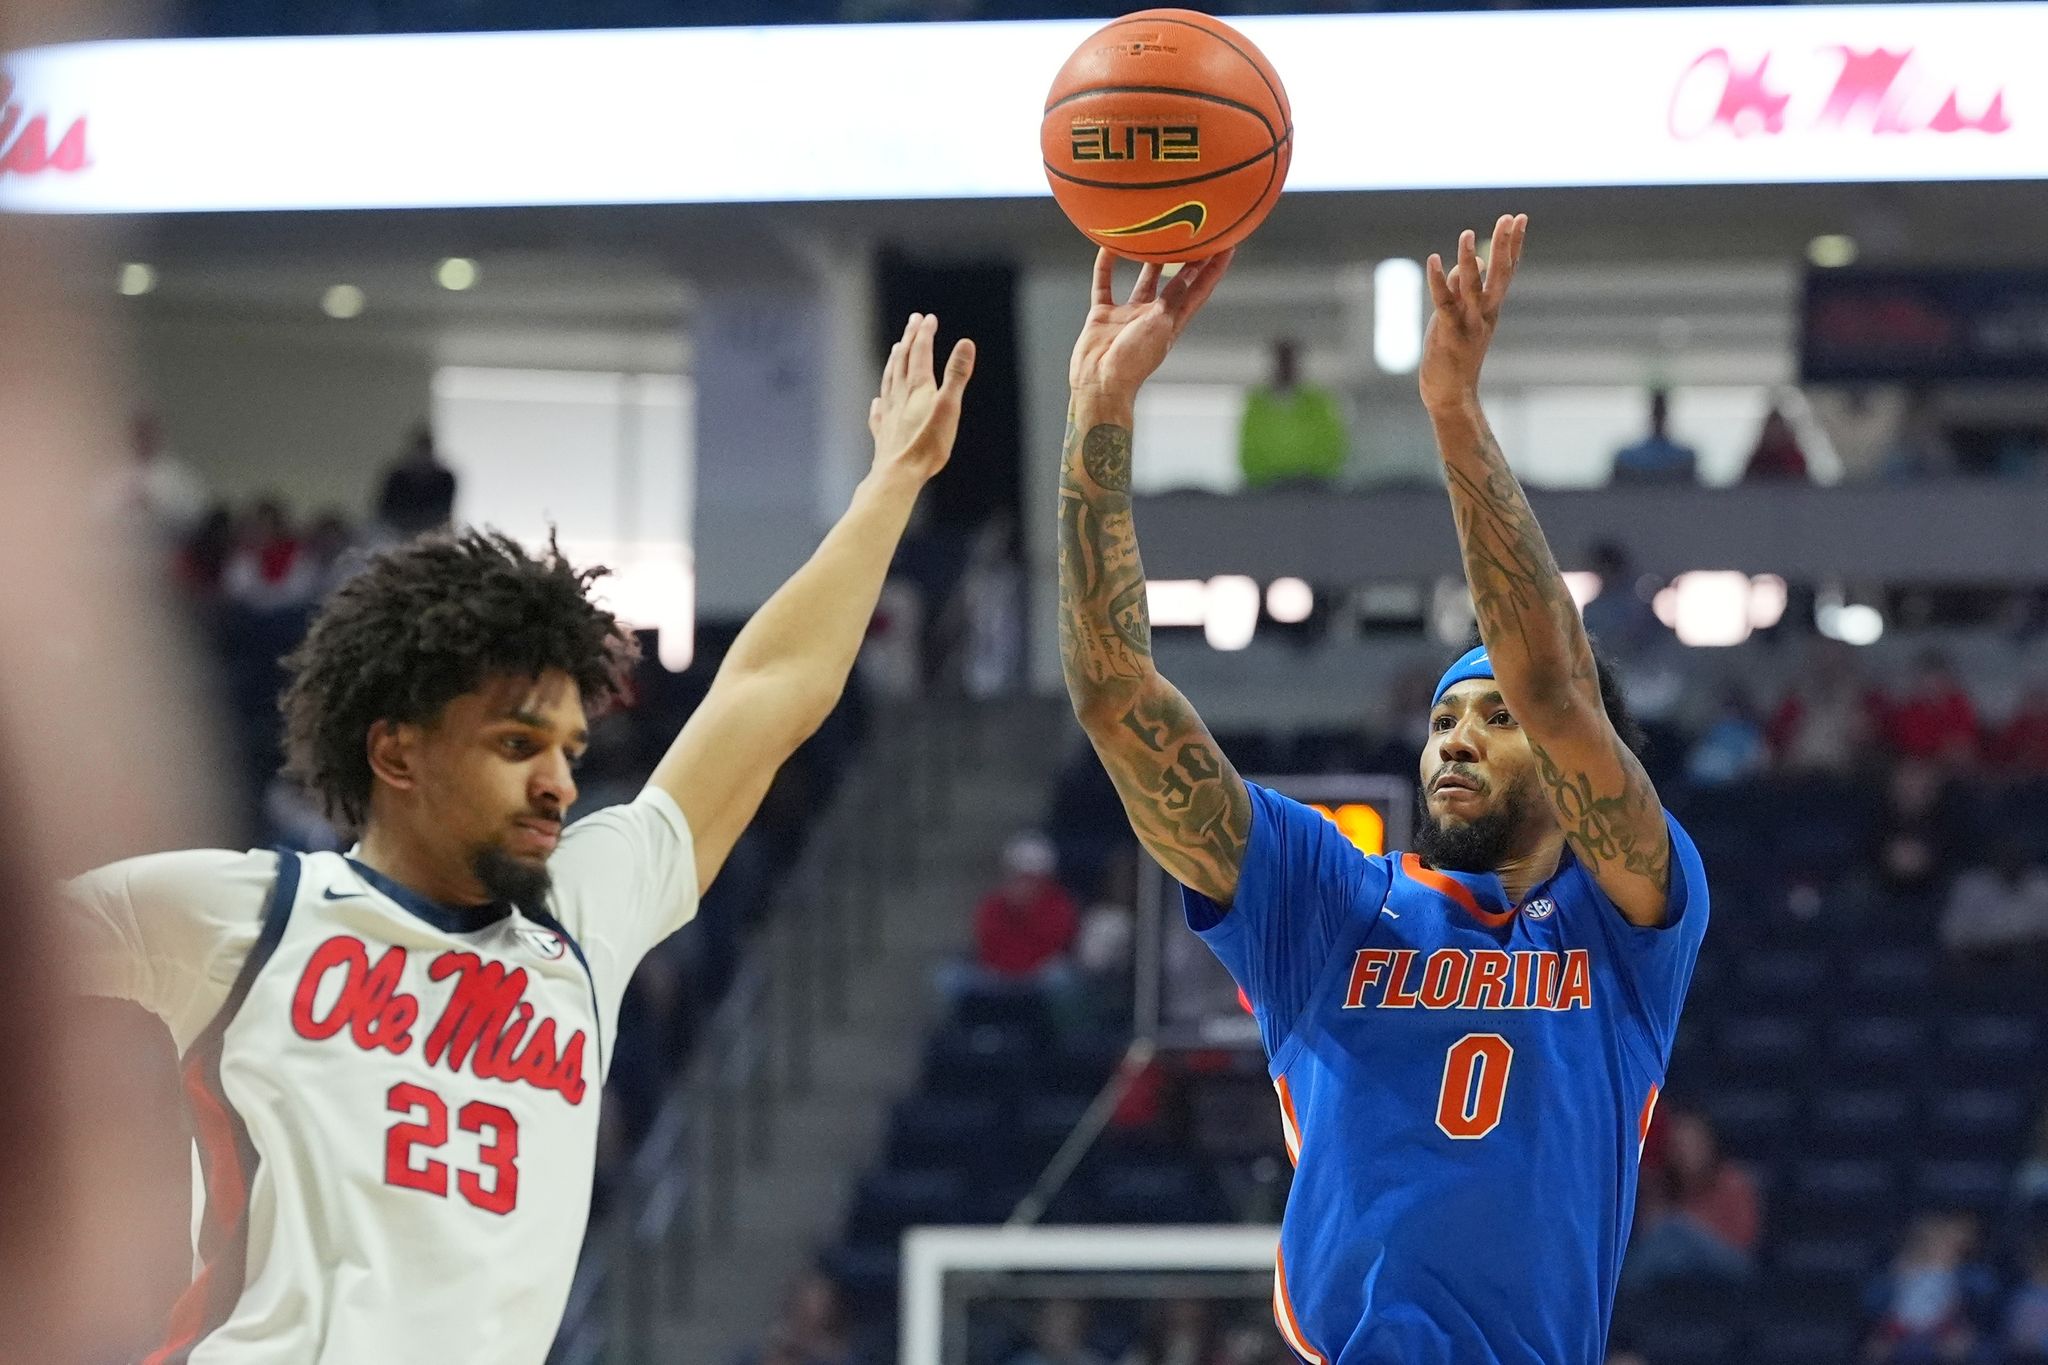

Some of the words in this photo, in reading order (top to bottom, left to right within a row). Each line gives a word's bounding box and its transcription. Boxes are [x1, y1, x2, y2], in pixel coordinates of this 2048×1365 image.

[1071, 126, 1201, 162] ELITE
[1524, 899, 1552, 918] SEC
[291, 935, 419, 1056] Ole
[423, 950, 586, 1106] Miss
[1342, 948, 1592, 1012] FLORIDA
[1434, 1032, 1514, 1140] 0
[384, 1081, 519, 1216] 23
